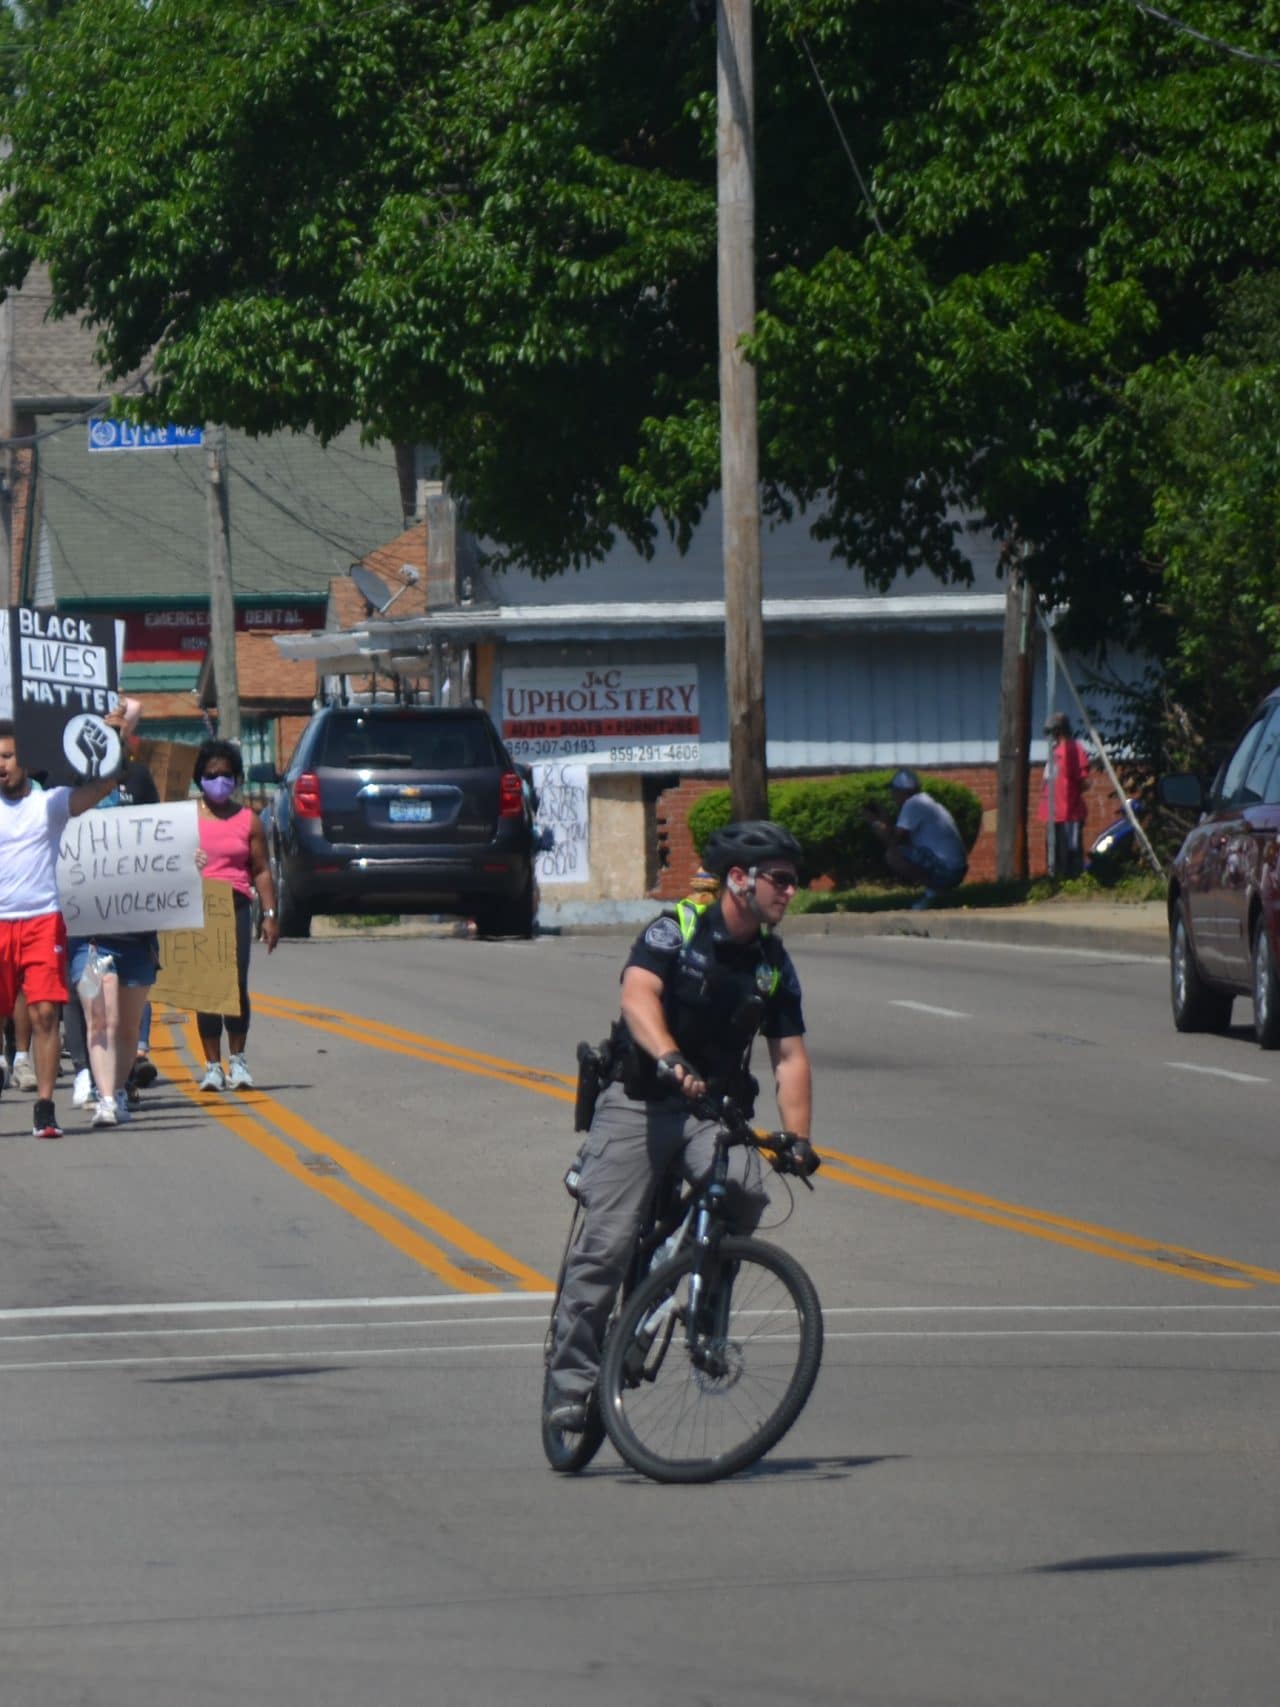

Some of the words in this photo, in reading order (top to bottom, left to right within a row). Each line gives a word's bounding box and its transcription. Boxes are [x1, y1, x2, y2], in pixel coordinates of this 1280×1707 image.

[20, 607, 94, 642] BLACK
[28, 643, 97, 679] LIVES
[22, 680, 120, 713] MATTER
[507, 684, 696, 717] UPHOLSTERY
[59, 814, 174, 862] WHITE
[70, 855, 181, 885] SILENCE
[95, 889, 191, 921] VIOLENCE
